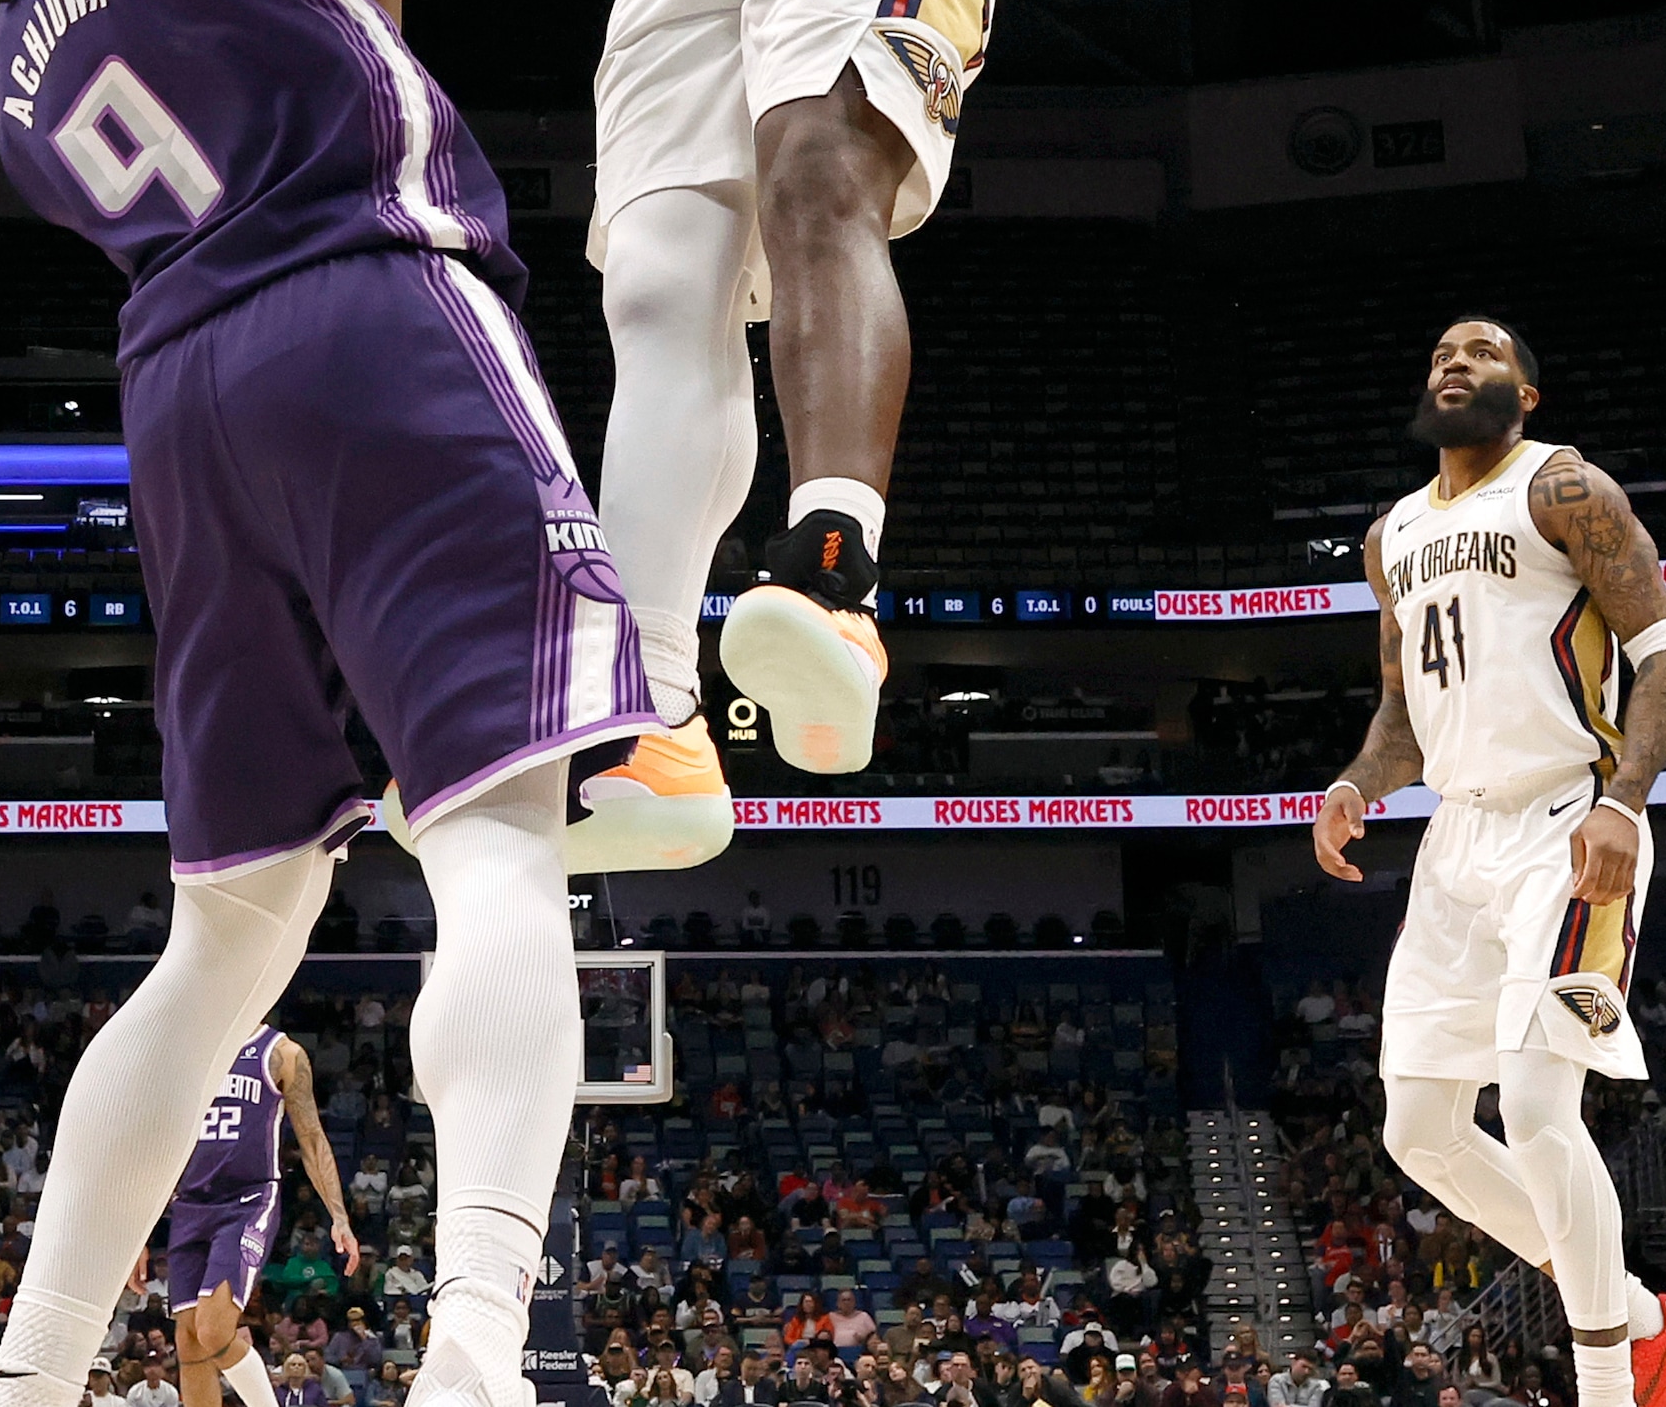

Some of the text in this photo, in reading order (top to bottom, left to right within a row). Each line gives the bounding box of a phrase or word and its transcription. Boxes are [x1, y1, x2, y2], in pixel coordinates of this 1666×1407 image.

[48, 54, 224, 226] 9
[545, 522, 611, 553] KIN
[1420, 531, 1517, 580] ORLEANS
[64, 600, 76, 617] 6
[105, 602, 124, 615] RB
[904, 598, 924, 615] 11
[944, 600, 963, 612] RB
[991, 598, 1003, 615] 6
[1085, 597, 1096, 614] 0
[1112, 598, 1153, 612] FOULS
[1158, 588, 1331, 615] OUSES MARKETS
[1421, 595, 1465, 690] 41
[728, 729, 758, 740] HUB
[18, 804, 122, 829] MARKETS
[777, 801, 881, 825] MARKETS
[935, 800, 1133, 824] ROUSES MARKETS
[1187, 798, 1271, 823] ROUSES
[832, 864, 881, 906] 119
[198, 1106, 241, 1140] 22
[539, 1350, 577, 1361] Keesler
[539, 1360, 577, 1370] Federal
